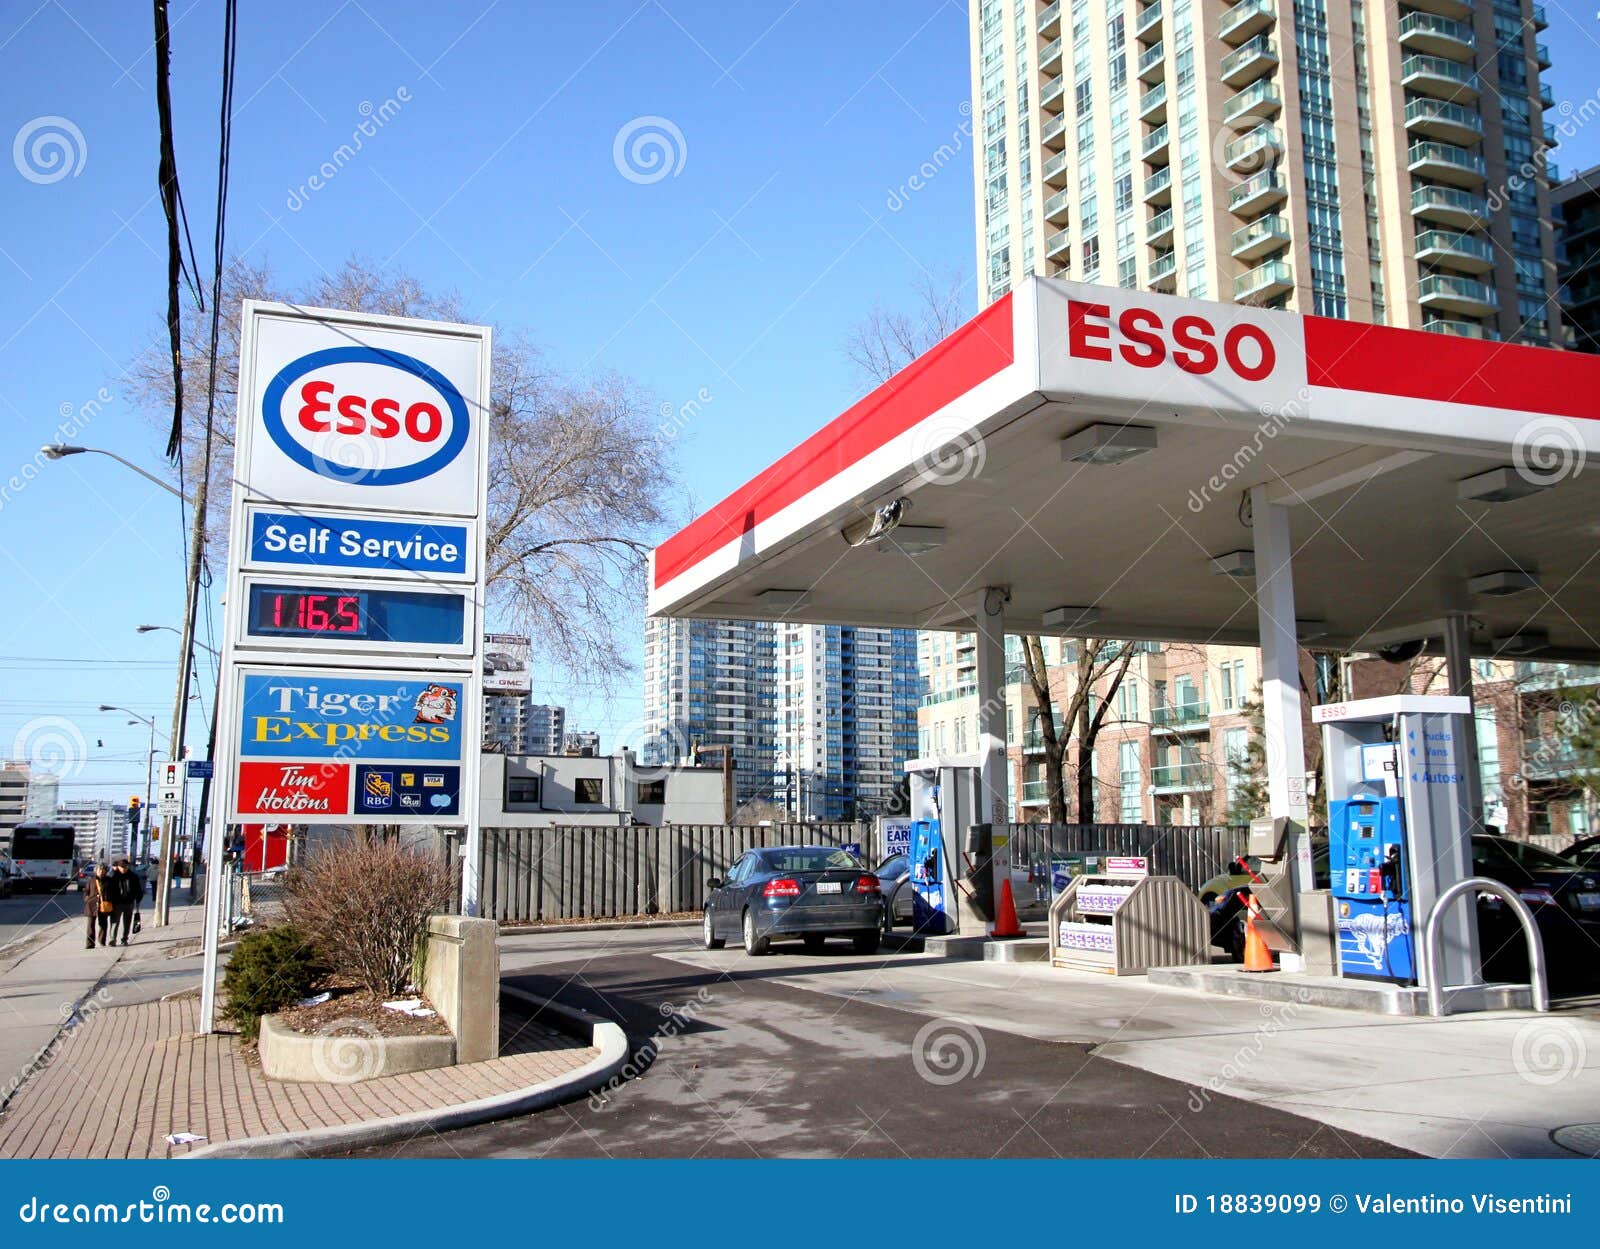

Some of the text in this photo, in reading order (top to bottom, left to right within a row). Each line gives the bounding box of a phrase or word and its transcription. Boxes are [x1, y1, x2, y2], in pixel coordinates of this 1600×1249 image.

[1067, 300, 1276, 381] ESSO
[298, 381, 442, 442] Esso
[264, 525, 458, 562] Self Service
[273, 595, 360, 632] 116.5
[269, 685, 400, 717] Tiger
[1321, 705, 1347, 719] ESSO
[250, 715, 450, 746] Express
[1422, 731, 1453, 741] rucks
[280, 766, 315, 788] Tim
[1422, 772, 1458, 784] Autos
[255, 787, 329, 811] Hortons
[366, 796, 389, 806] RBC
[887, 846, 911, 854] FASTE
